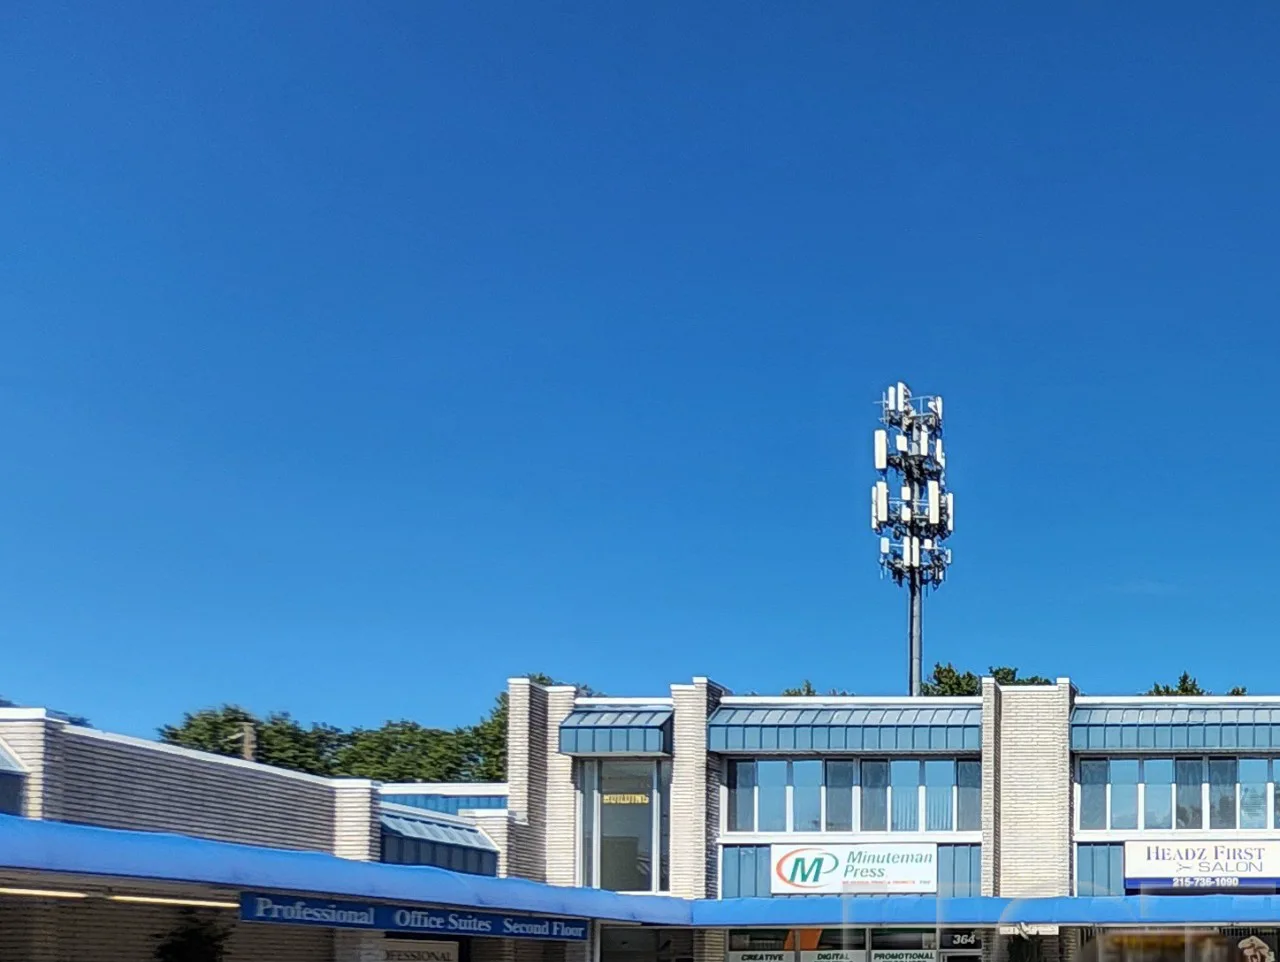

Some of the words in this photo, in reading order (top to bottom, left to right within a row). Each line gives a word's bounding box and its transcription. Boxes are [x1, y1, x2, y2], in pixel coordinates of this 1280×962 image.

[847, 851, 932, 864] Minuteman
[1147, 846, 1208, 861] HEADZ
[1214, 846, 1266, 860] FIRST
[844, 865, 886, 878] Press
[1198, 862, 1263, 872] SALON
[255, 897, 375, 925] Professional
[395, 909, 445, 930] Office
[447, 913, 492, 932] Suites
[503, 918, 549, 936] Second
[552, 921, 585, 937] Floor
[953, 934, 976, 945] 364
[741, 953, 784, 961] CREATIVE
[817, 953, 850, 961] DIGITAL
[873, 952, 935, 960] PROMOTIONAL
